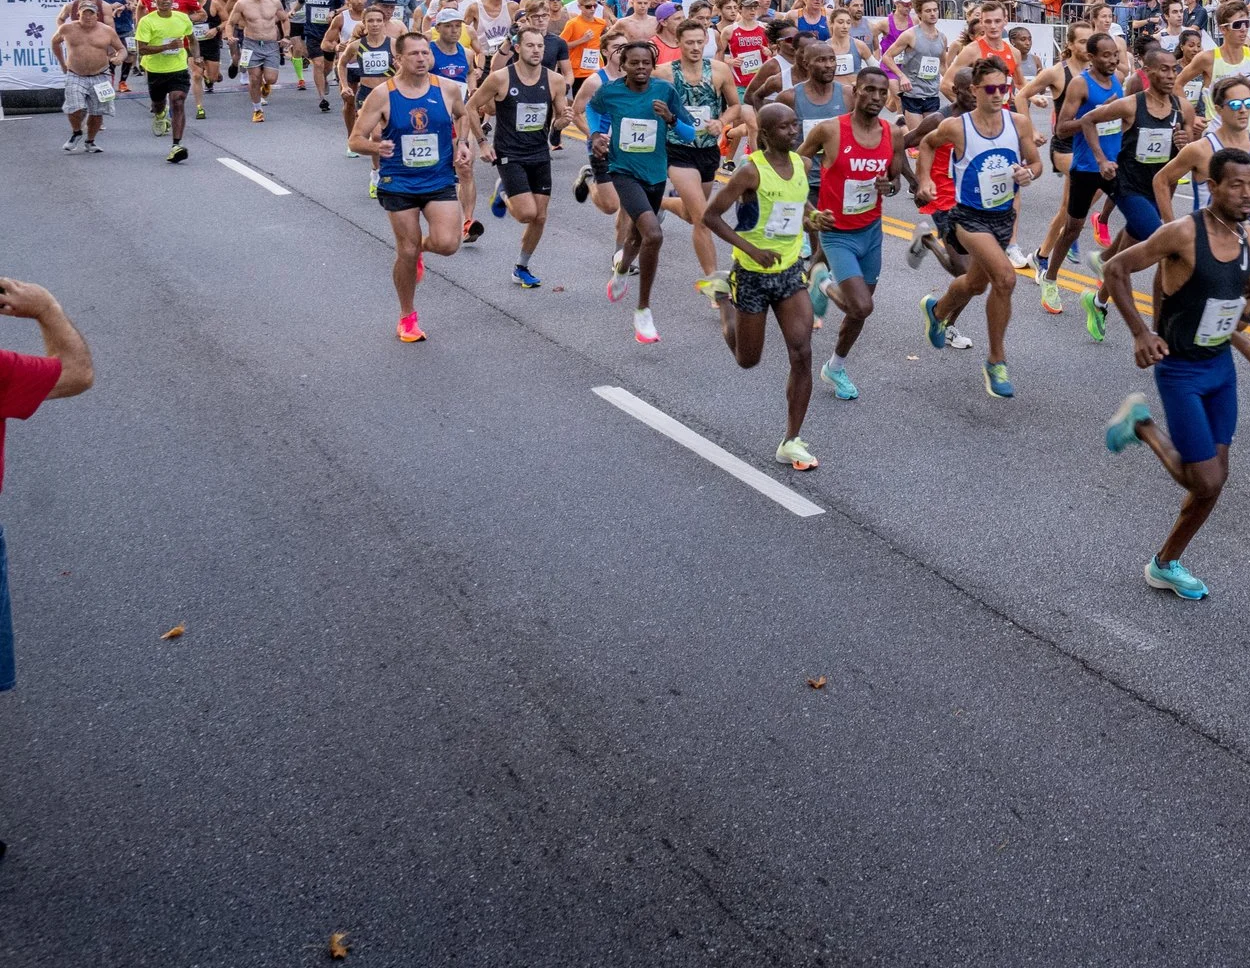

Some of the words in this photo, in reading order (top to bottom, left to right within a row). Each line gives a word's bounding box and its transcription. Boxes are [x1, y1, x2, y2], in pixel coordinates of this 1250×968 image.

[14, 48, 46, 66] MILE
[364, 60, 387, 68] 2003
[744, 59, 759, 68] 950
[922, 65, 937, 73] 1089
[524, 114, 538, 123] 28
[631, 133, 645, 142] 14
[408, 147, 432, 158] 422
[1147, 142, 1161, 153] 42
[850, 158, 887, 172] WSX
[992, 183, 1006, 195] 30
[856, 193, 870, 204] 12
[782, 219, 790, 229] 7
[1216, 318, 1232, 332] 15
